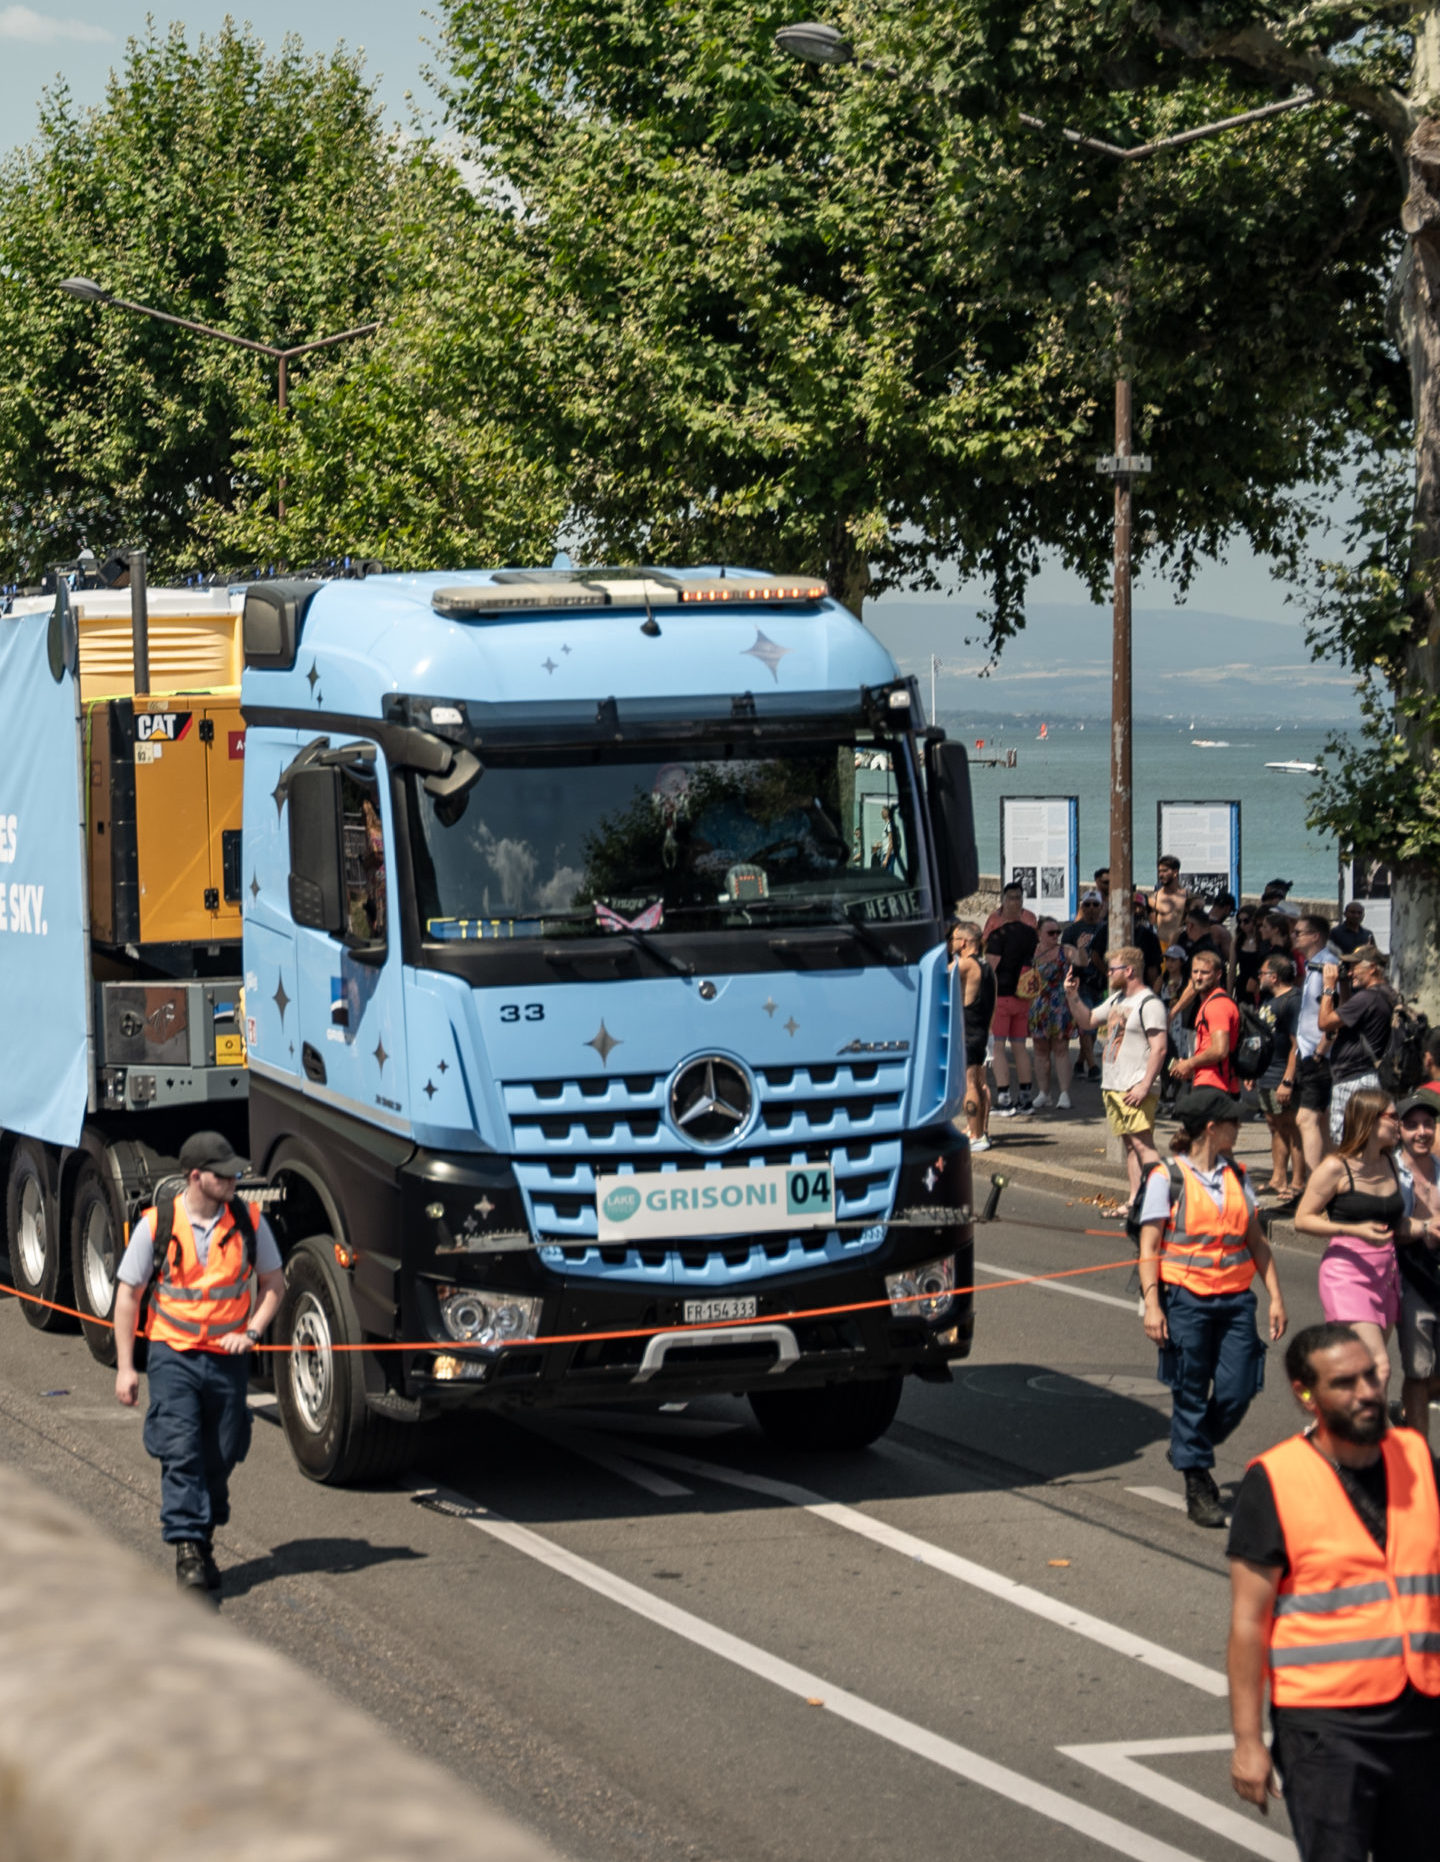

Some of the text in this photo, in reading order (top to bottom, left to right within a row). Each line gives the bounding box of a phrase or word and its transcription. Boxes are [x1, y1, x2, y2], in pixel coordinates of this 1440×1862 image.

[138, 713, 177, 740] CAT
[9, 883, 48, 936] SKY.
[500, 1004, 545, 1022] 33
[645, 1172, 831, 1211] GRISONI 04
